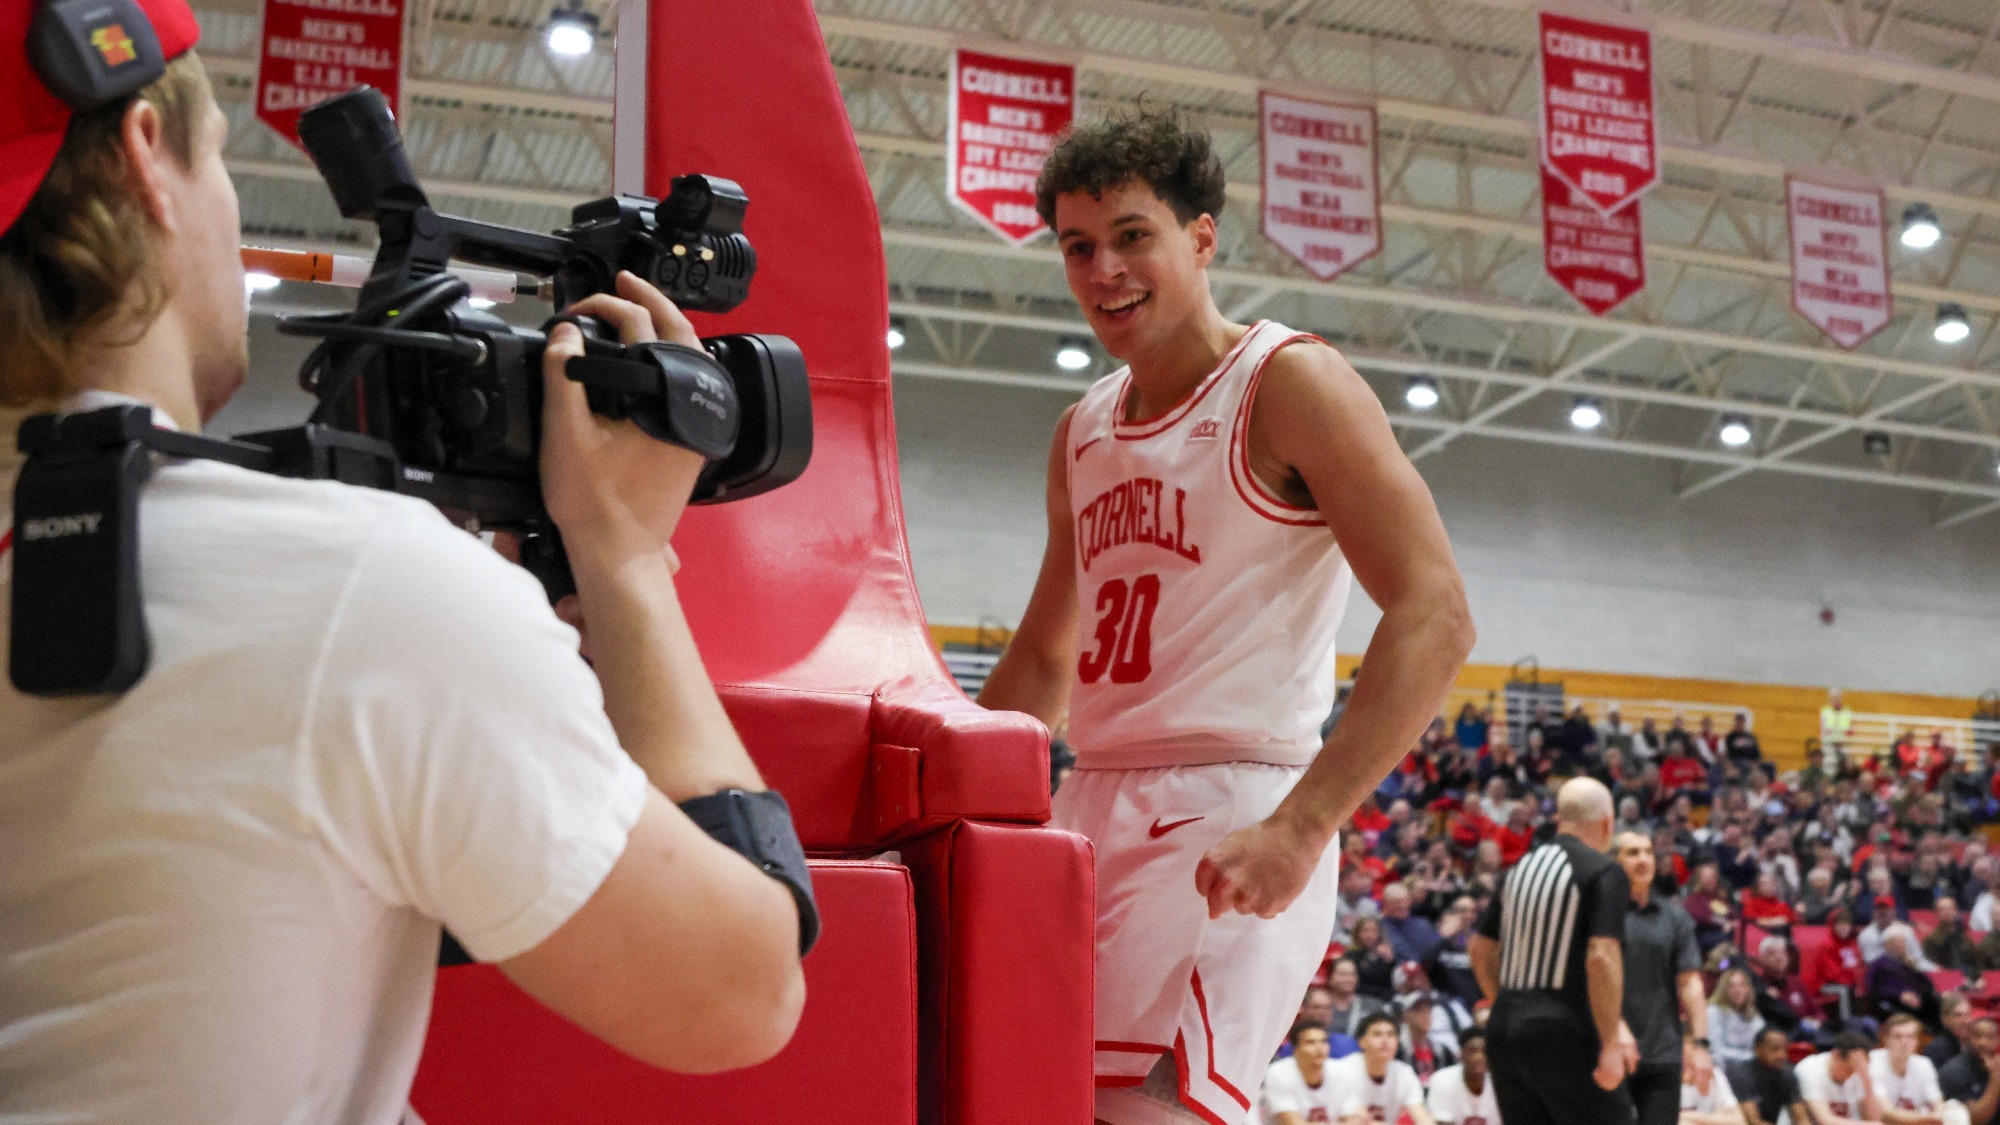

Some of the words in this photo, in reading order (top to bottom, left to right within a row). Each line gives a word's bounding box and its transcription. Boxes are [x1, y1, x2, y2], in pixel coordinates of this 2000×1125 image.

[268, 36, 392, 69] BASKETBALL
[1546, 30, 1645, 71] CORNELL
[961, 66, 1069, 105] CORNELL
[1572, 69, 1625, 95] MEN'S
[988, 105, 1044, 129] MEN'S
[1550, 86, 1650, 120] BASKETBALL
[1270, 111, 1367, 147] CORNELL
[1585, 115, 1645, 140] LEAGUE
[1551, 131, 1649, 171] CHAMPIONS
[1275, 163, 1364, 190] BASKETBALL
[1270, 205, 1373, 235] TOURNAMENT
[1797, 196, 1877, 228] CORNELL
[403, 467, 434, 483] SONY
[22, 512, 103, 541] SONY
[1078, 477, 1201, 573] CORNELL
[1078, 573, 1161, 684] 30
